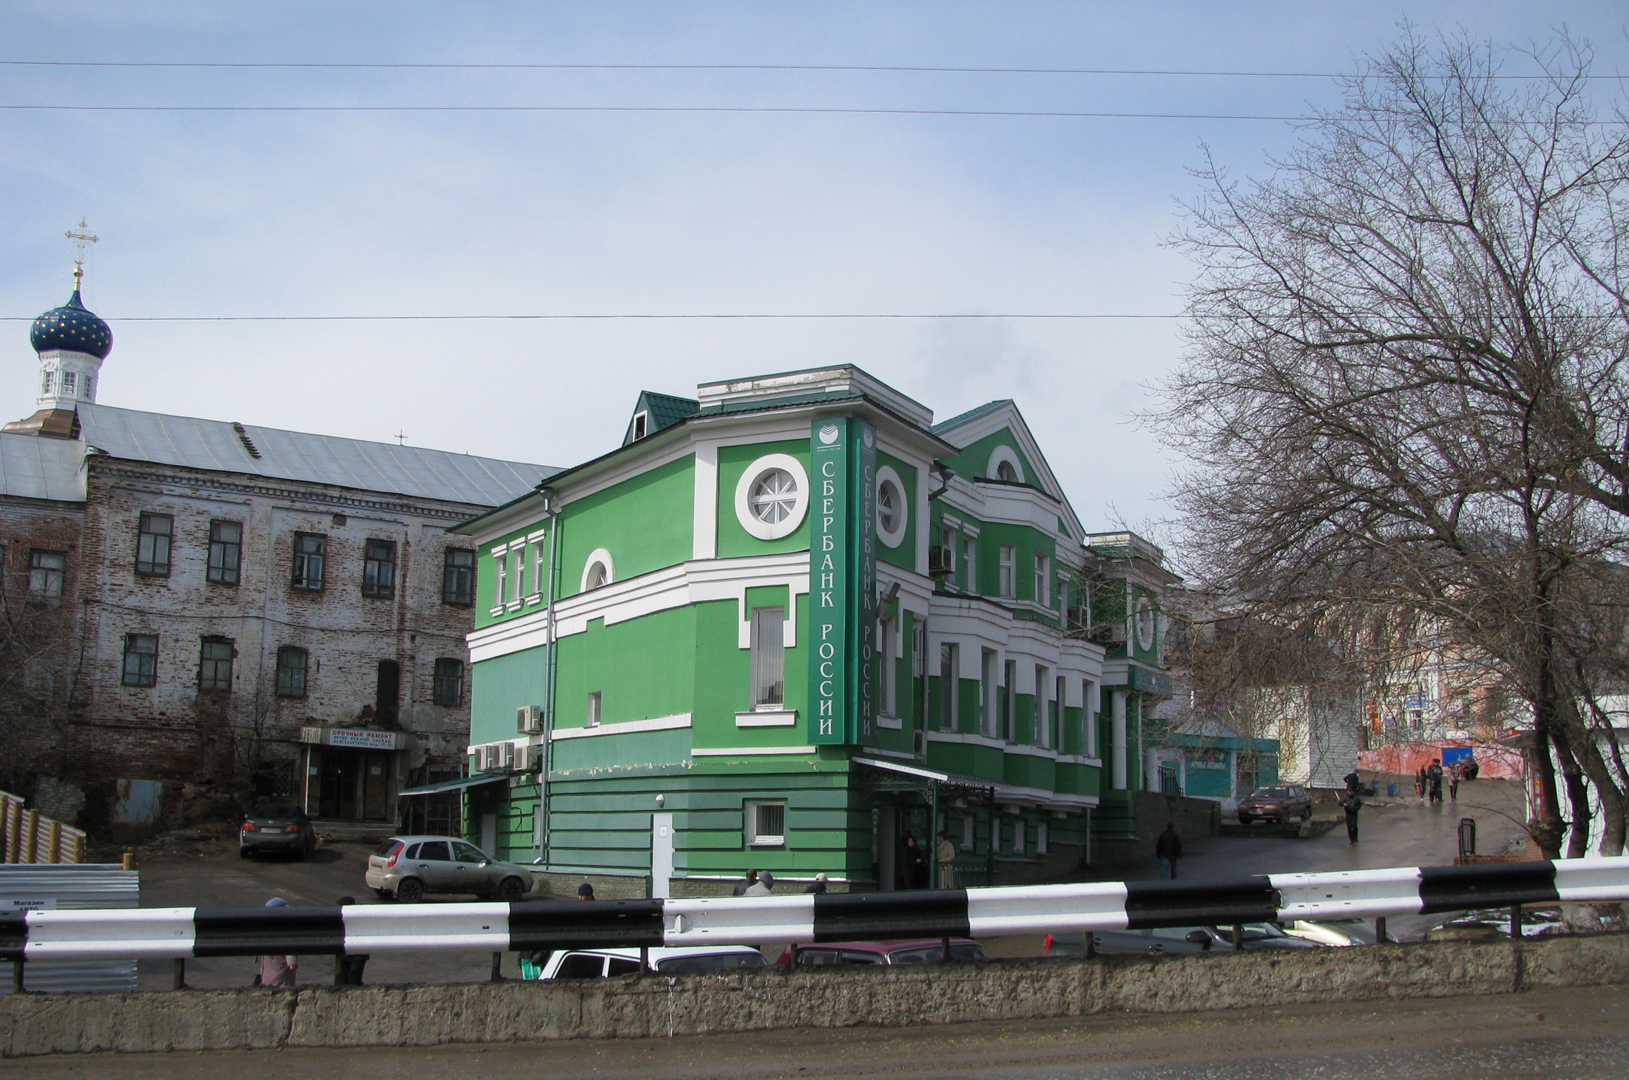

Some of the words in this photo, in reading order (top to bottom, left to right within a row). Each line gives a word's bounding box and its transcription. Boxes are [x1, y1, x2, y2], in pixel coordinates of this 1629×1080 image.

[820, 461, 836, 608] СБЕРБАНК
[863, 464, 872, 610] СБЕРБАНК
[819, 623, 835, 736] РОССИИ
[862, 625, 872, 737] РОССИИ
